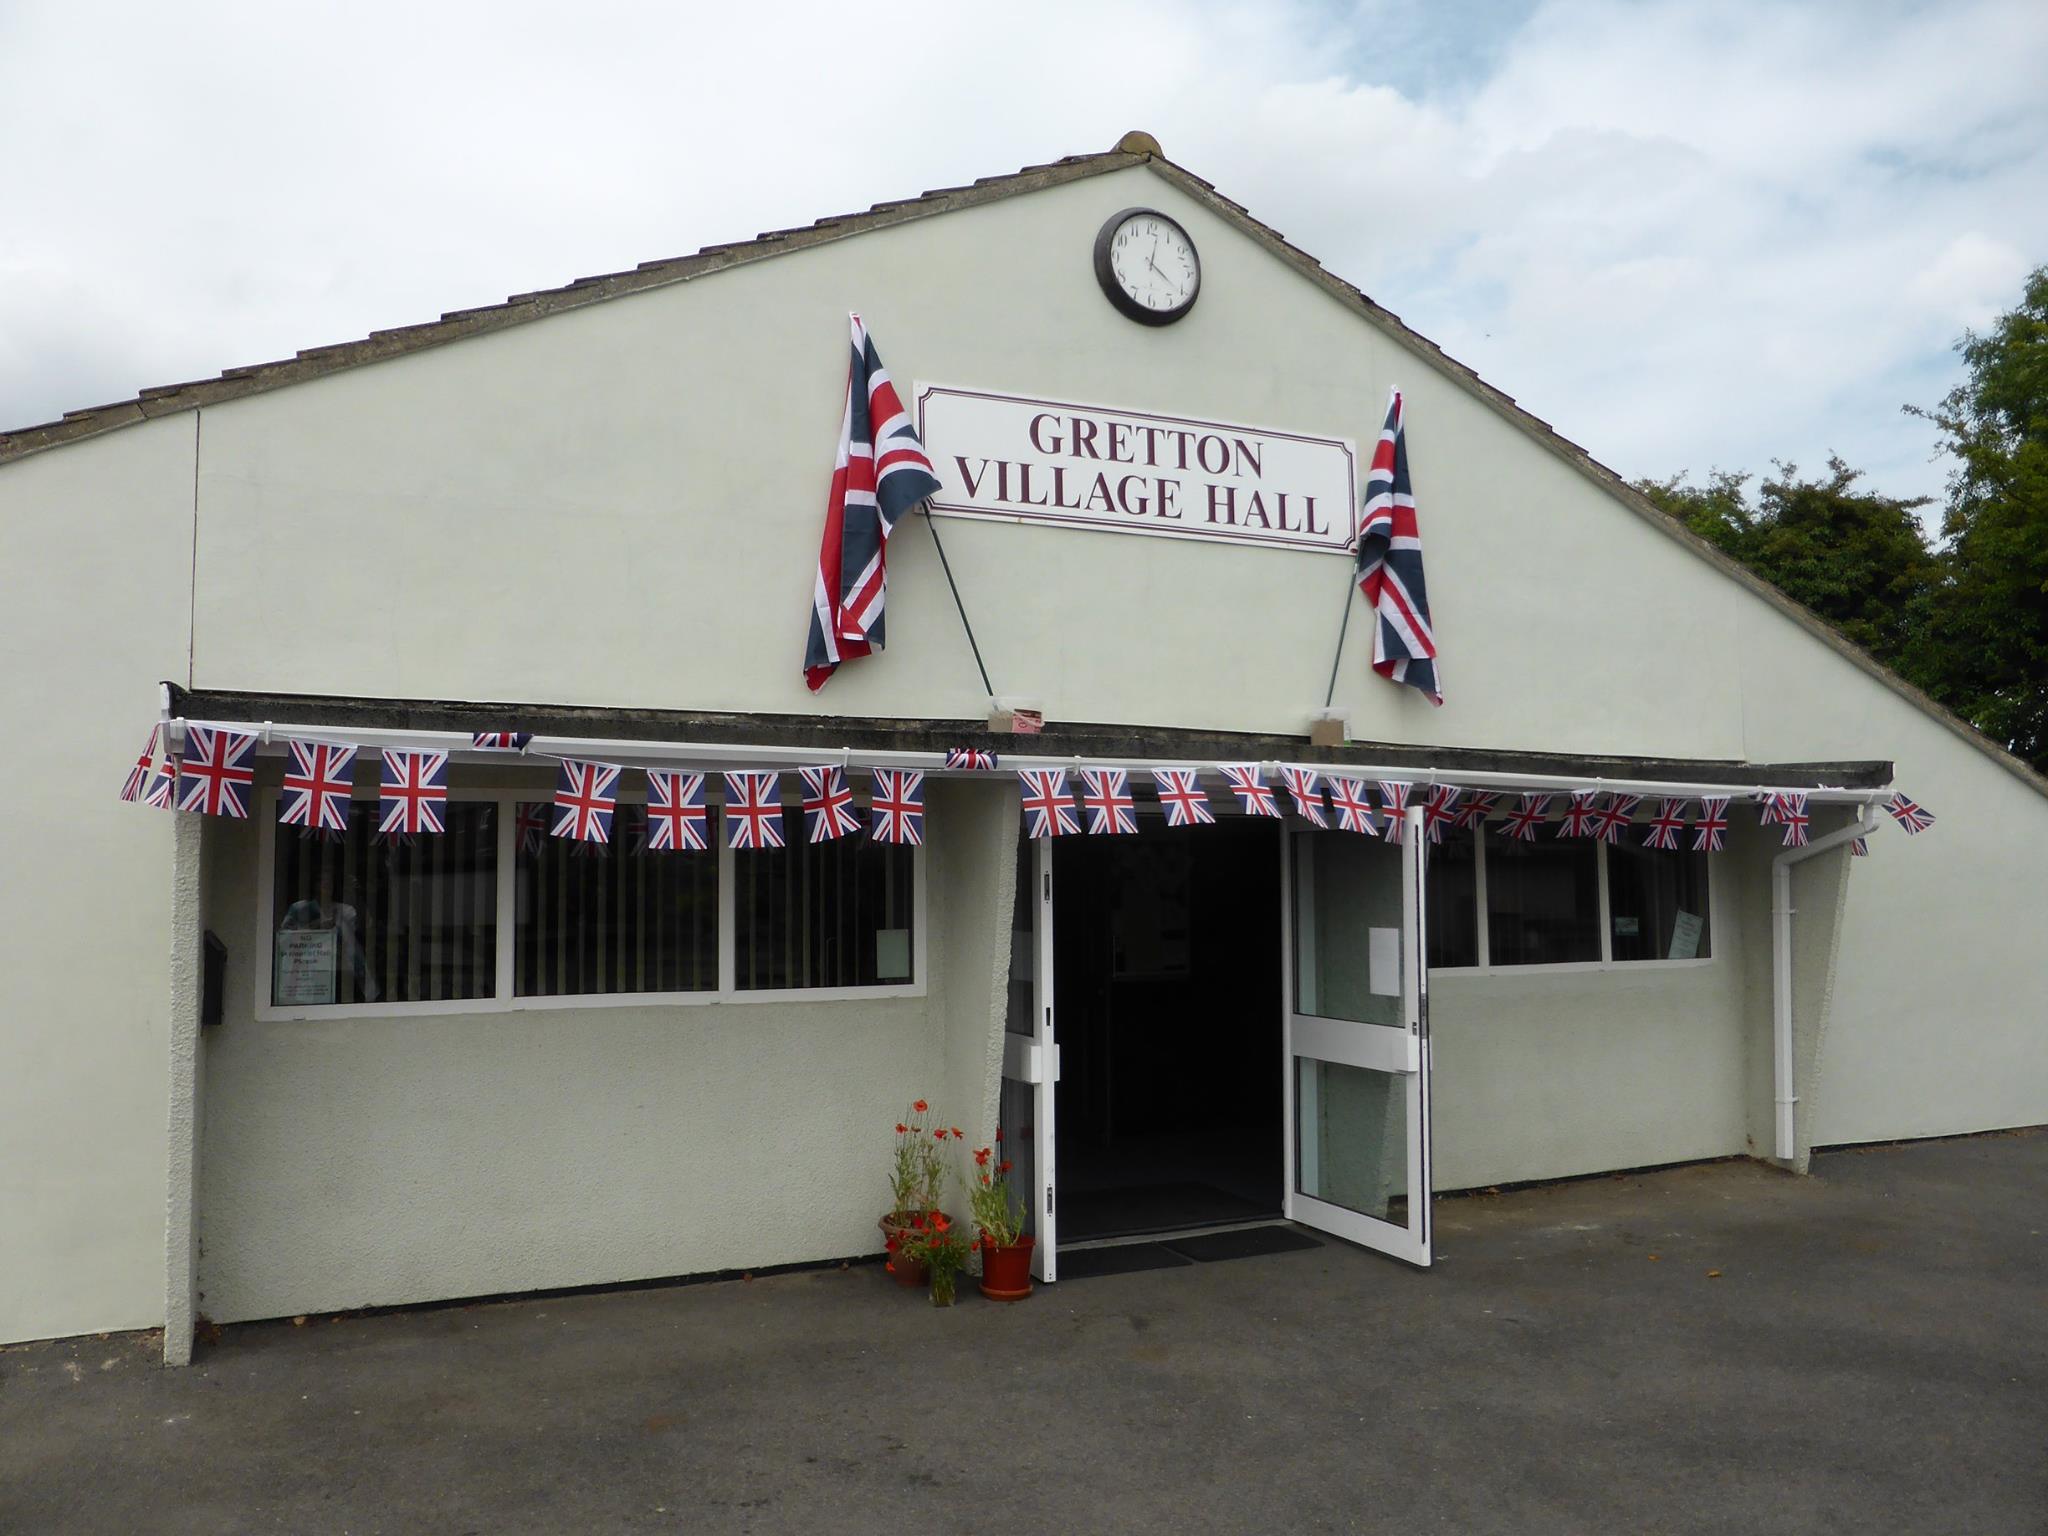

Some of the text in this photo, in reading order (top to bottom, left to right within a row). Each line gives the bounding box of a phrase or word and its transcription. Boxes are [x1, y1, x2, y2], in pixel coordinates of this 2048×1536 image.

[1029, 413, 1264, 479] GRETTON
[953, 455, 1330, 536] VILLAGE HALL
